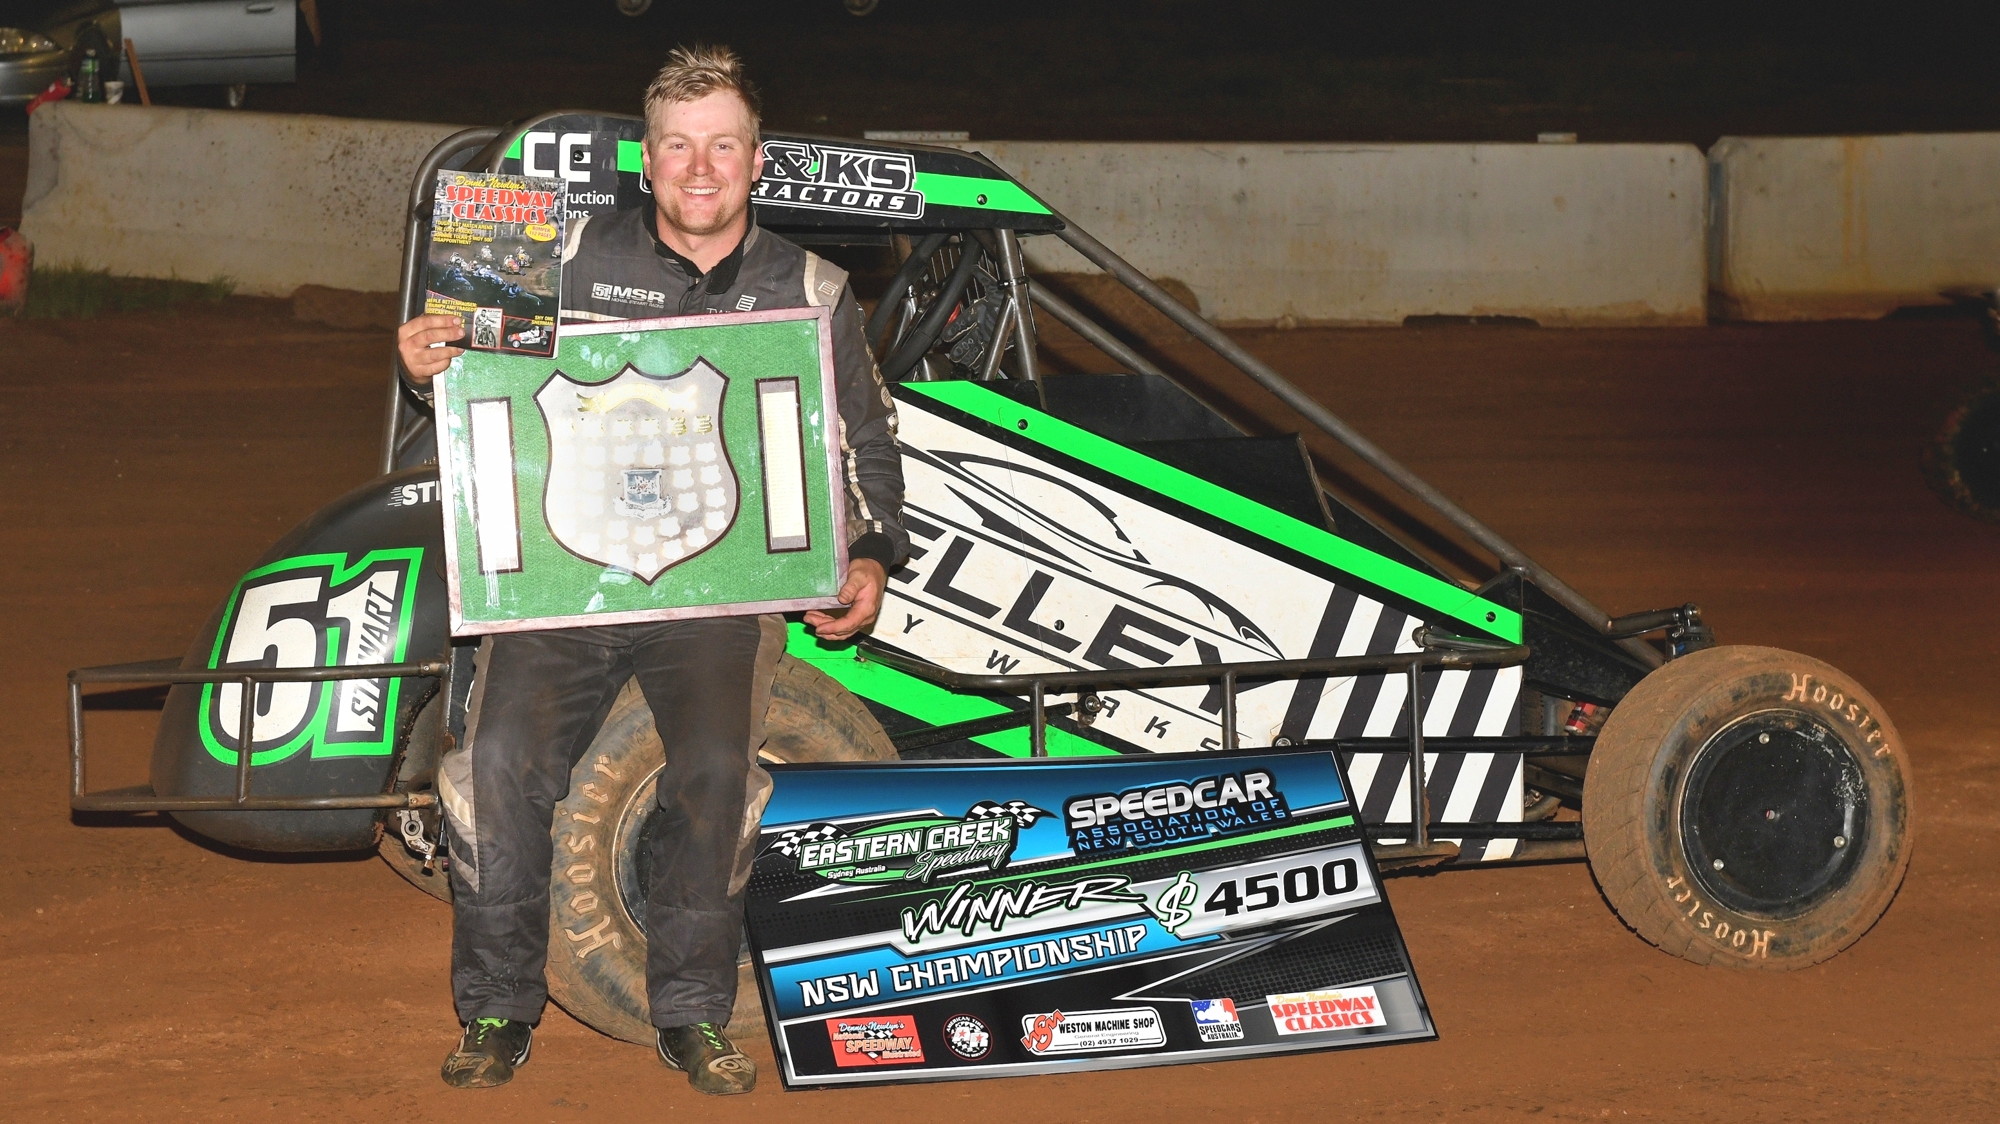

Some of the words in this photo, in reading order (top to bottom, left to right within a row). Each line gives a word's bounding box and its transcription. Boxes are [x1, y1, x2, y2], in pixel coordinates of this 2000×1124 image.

[455, 175, 487, 187] Dennis
[489, 177, 525, 190] Newlyn's
[445, 185, 557, 208] SPEEDWAY
[566, 190, 615, 205] ruction
[751, 182, 906, 210] RACTORS
[452, 203, 547, 225] CLASSICS
[433, 237, 472, 245] DISAPPOINTMENT
[594, 285, 609, 298] 51
[612, 285, 666, 305] MSR
[888, 513, 1281, 716] ELLEY
[210, 560, 411, 746] 51
[351, 580, 394, 727] STWART
[1782, 672, 1890, 756] Hoosier
[1068, 772, 1274, 829] SPEEDCAR
[1076, 806, 1236, 840] ASSOCIATION
[1252, 799, 1280, 812] OF
[1078, 835, 1121, 851] NEW
[1135, 823, 1204, 841] SOUTH
[1216, 809, 1286, 828] WALES
[801, 830, 920, 868] EASTERN
[927, 818, 1011, 851] CREEK
[564, 755, 622, 959] Hoosier
[903, 840, 1009, 883] Speedway
[827, 869, 855, 880] Sydney
[855, 864, 886, 875] Australia
[902, 876, 1146, 941] WINNER
[1204, 857, 1358, 918] 4500
[1667, 876, 1775, 959] Hoosier
[799, 970, 880, 1008] NSW
[890, 924, 1148, 992] CHAMPIONSHIP
[1271, 996, 1375, 1018] SPEEDWAY
[1275, 994, 1305, 1004] Dennis
[1306, 991, 1343, 1001] Newlyn's
[838, 1022, 867, 1032] Dennis
[868, 1020, 905, 1031] Newlyn's
[946, 1016, 970, 1033] AMERICAN
[972, 1018, 985, 1030] TIRE
[1058, 1021, 1092, 1034] WESTON
[1095, 1018, 1130, 1032] MACHINE
[1133, 1016, 1155, 1029] SHOP
[1199, 1022, 1241, 1035] SPEEDCARS
[1285, 1011, 1374, 1031] CLASSICS
[846, 1037, 913, 1053] SPEEDWAY
